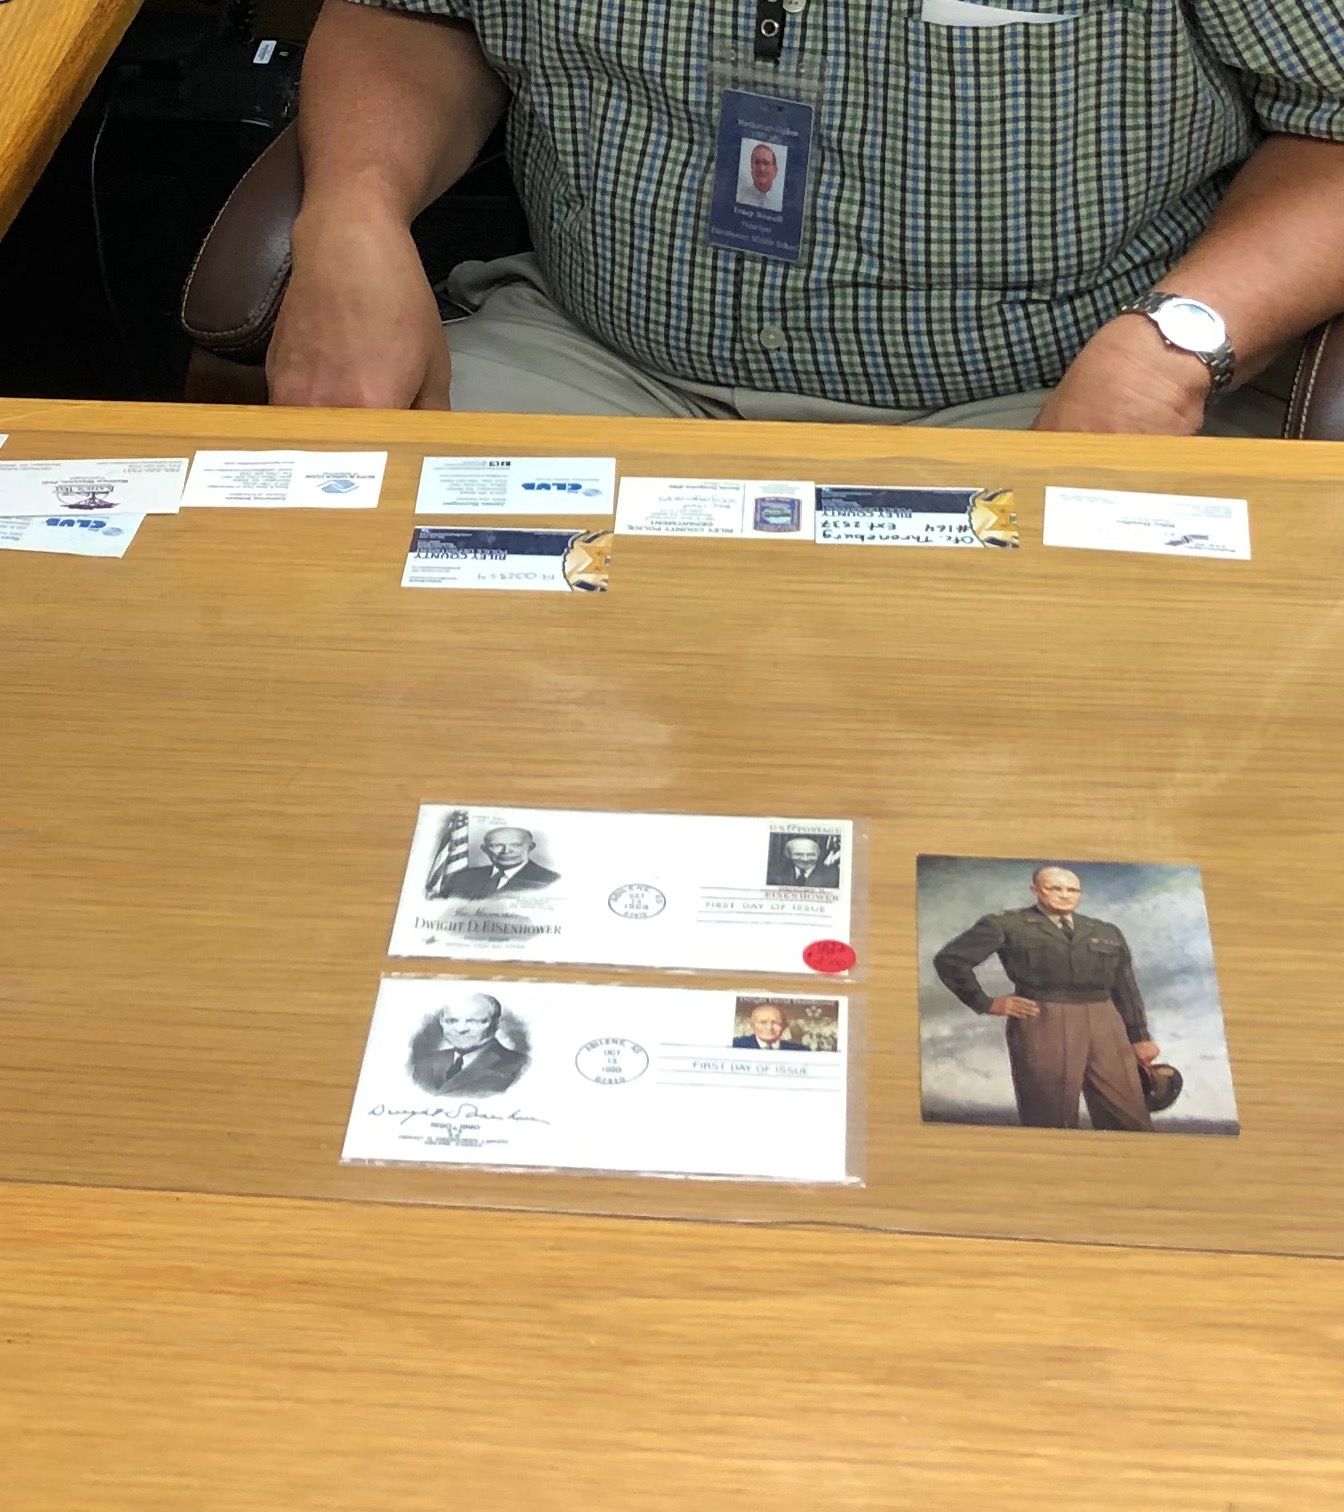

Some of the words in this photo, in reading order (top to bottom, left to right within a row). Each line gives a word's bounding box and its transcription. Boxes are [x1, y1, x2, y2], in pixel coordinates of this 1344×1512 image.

[822, 510, 874, 518] COUNTY
[924, 524, 969, 533] #164
[822, 529, 932, 544] Throneburg
[414, 552, 468, 560] COUNTY
[471, 552, 507, 561] RILEY
[706, 900, 735, 908] FIRST
[743, 902, 765, 910] DAY
[771, 903, 786, 911] OF
[792, 903, 826, 913] ISSUE
[414, 916, 464, 930] DWIGHT
[482, 919, 562, 935] EISENHOWER
[692, 1060, 727, 1071] FIRST
[730, 1063, 752, 1073] DAY
[756, 1065, 772, 1074] OF
[775, 1066, 809, 1076] ISSUE
